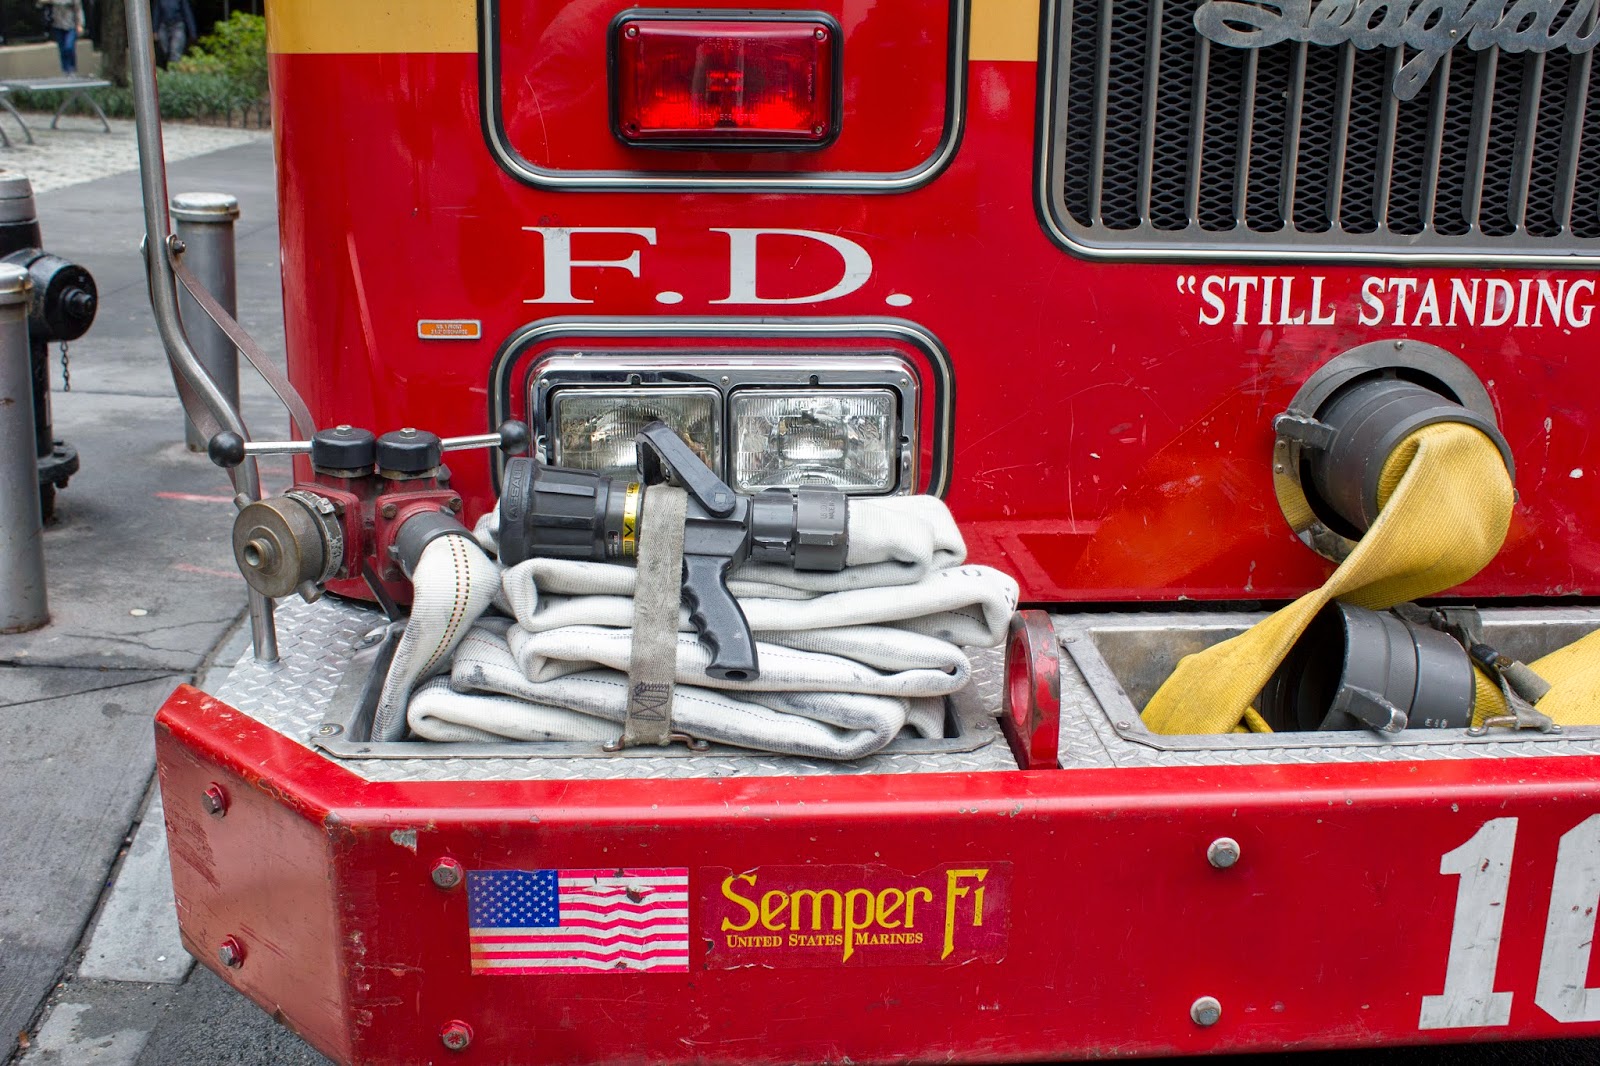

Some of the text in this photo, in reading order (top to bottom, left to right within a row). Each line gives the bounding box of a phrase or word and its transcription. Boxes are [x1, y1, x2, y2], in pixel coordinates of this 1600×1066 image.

[521, 226, 913, 305] F.D.
[1357, 276, 1597, 329] STANDING
[720, 868, 990, 964] Semper Fi
[726, 931, 924, 948] UNITED STATES MARINES
